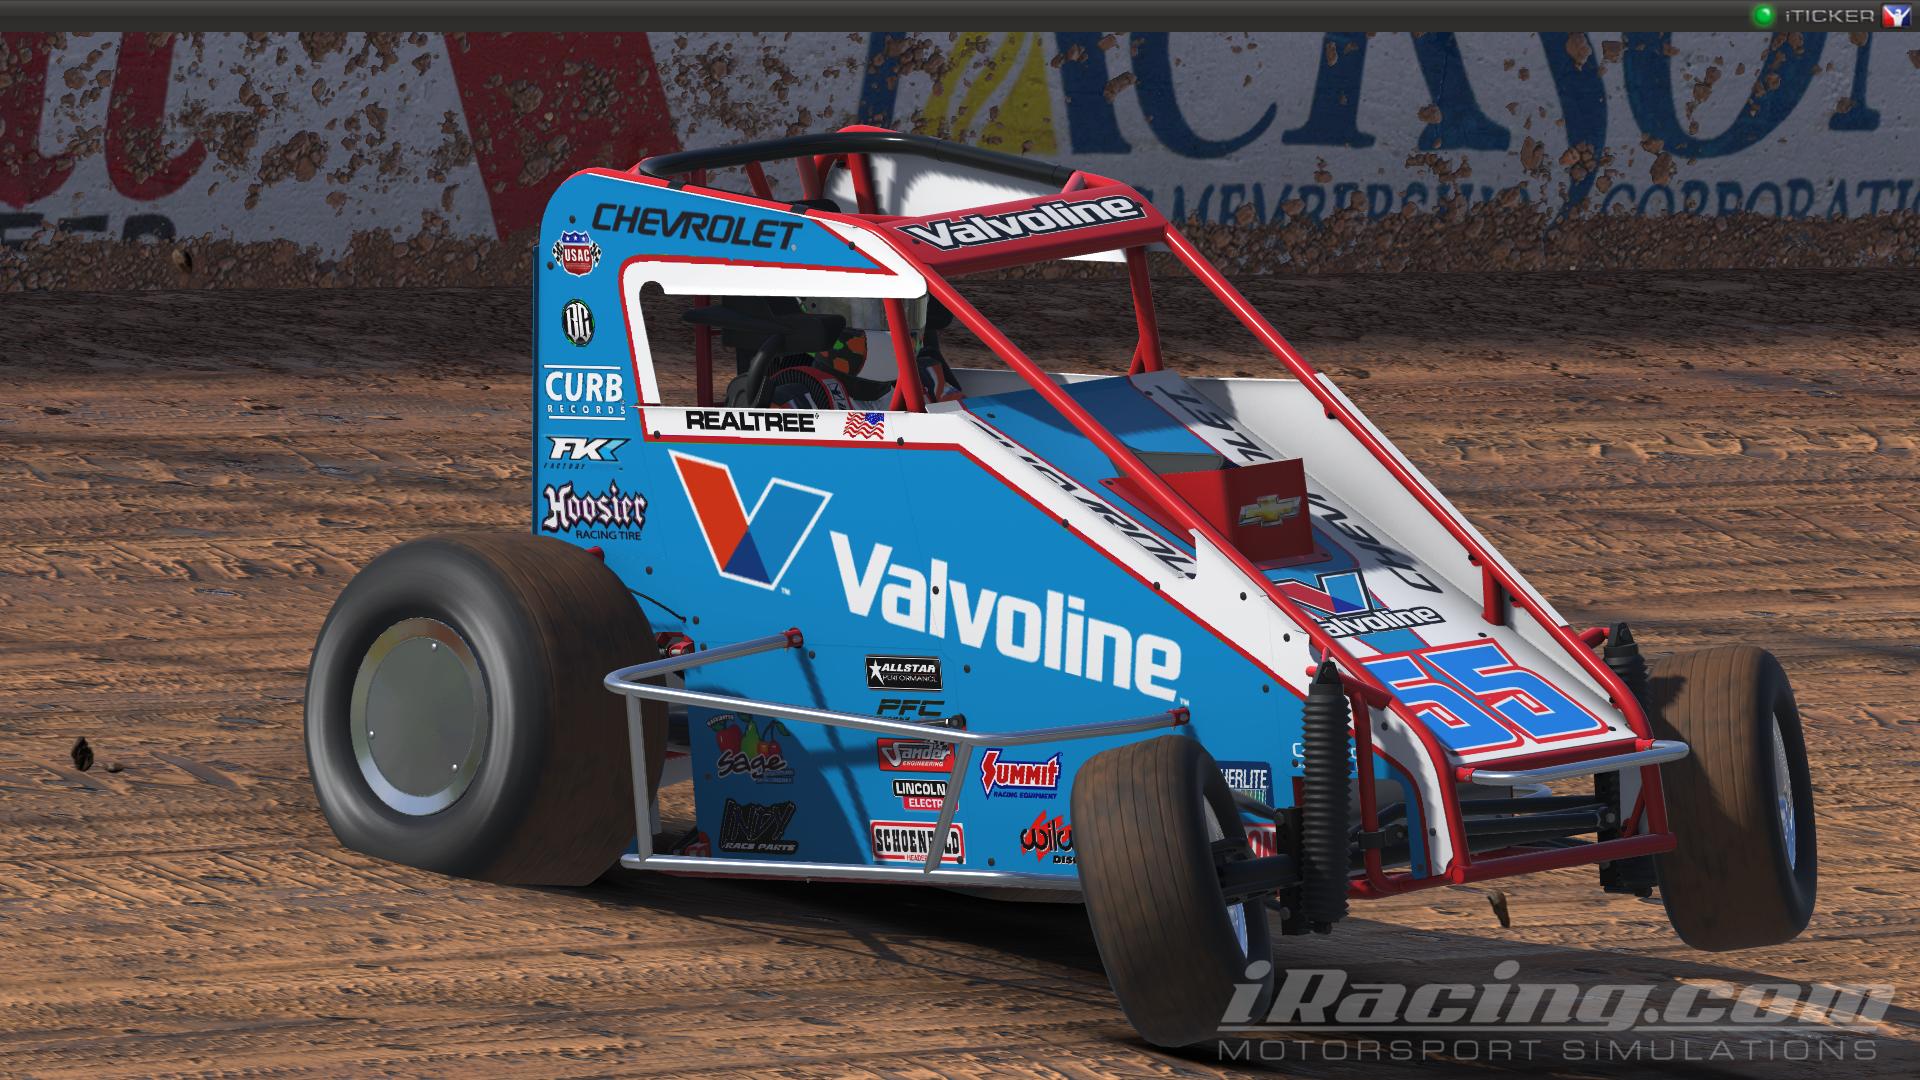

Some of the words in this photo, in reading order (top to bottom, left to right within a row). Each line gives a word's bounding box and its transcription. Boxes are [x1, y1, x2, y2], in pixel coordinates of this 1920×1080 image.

[592, 204, 803, 250] CHEVROLET
[900, 196, 1146, 249] Valvoline
[564, 248, 590, 262] USAC
[545, 371, 623, 402] CURB
[547, 404, 626, 415] RECORDS
[686, 411, 815, 432] REALTREE
[542, 479, 648, 533] Hoosier
[576, 530, 617, 540] RACING
[620, 531, 642, 541] TIRE
[829, 530, 1181, 702] Valvoline
[1318, 606, 1447, 639] alvoline
[881, 663, 936, 673] ALLSTAR
[877, 699, 945, 716] PFC
[1359, 638, 1609, 757] 55
[895, 782, 946, 796] LINCOLN
[908, 798, 943, 808] ELECTR
